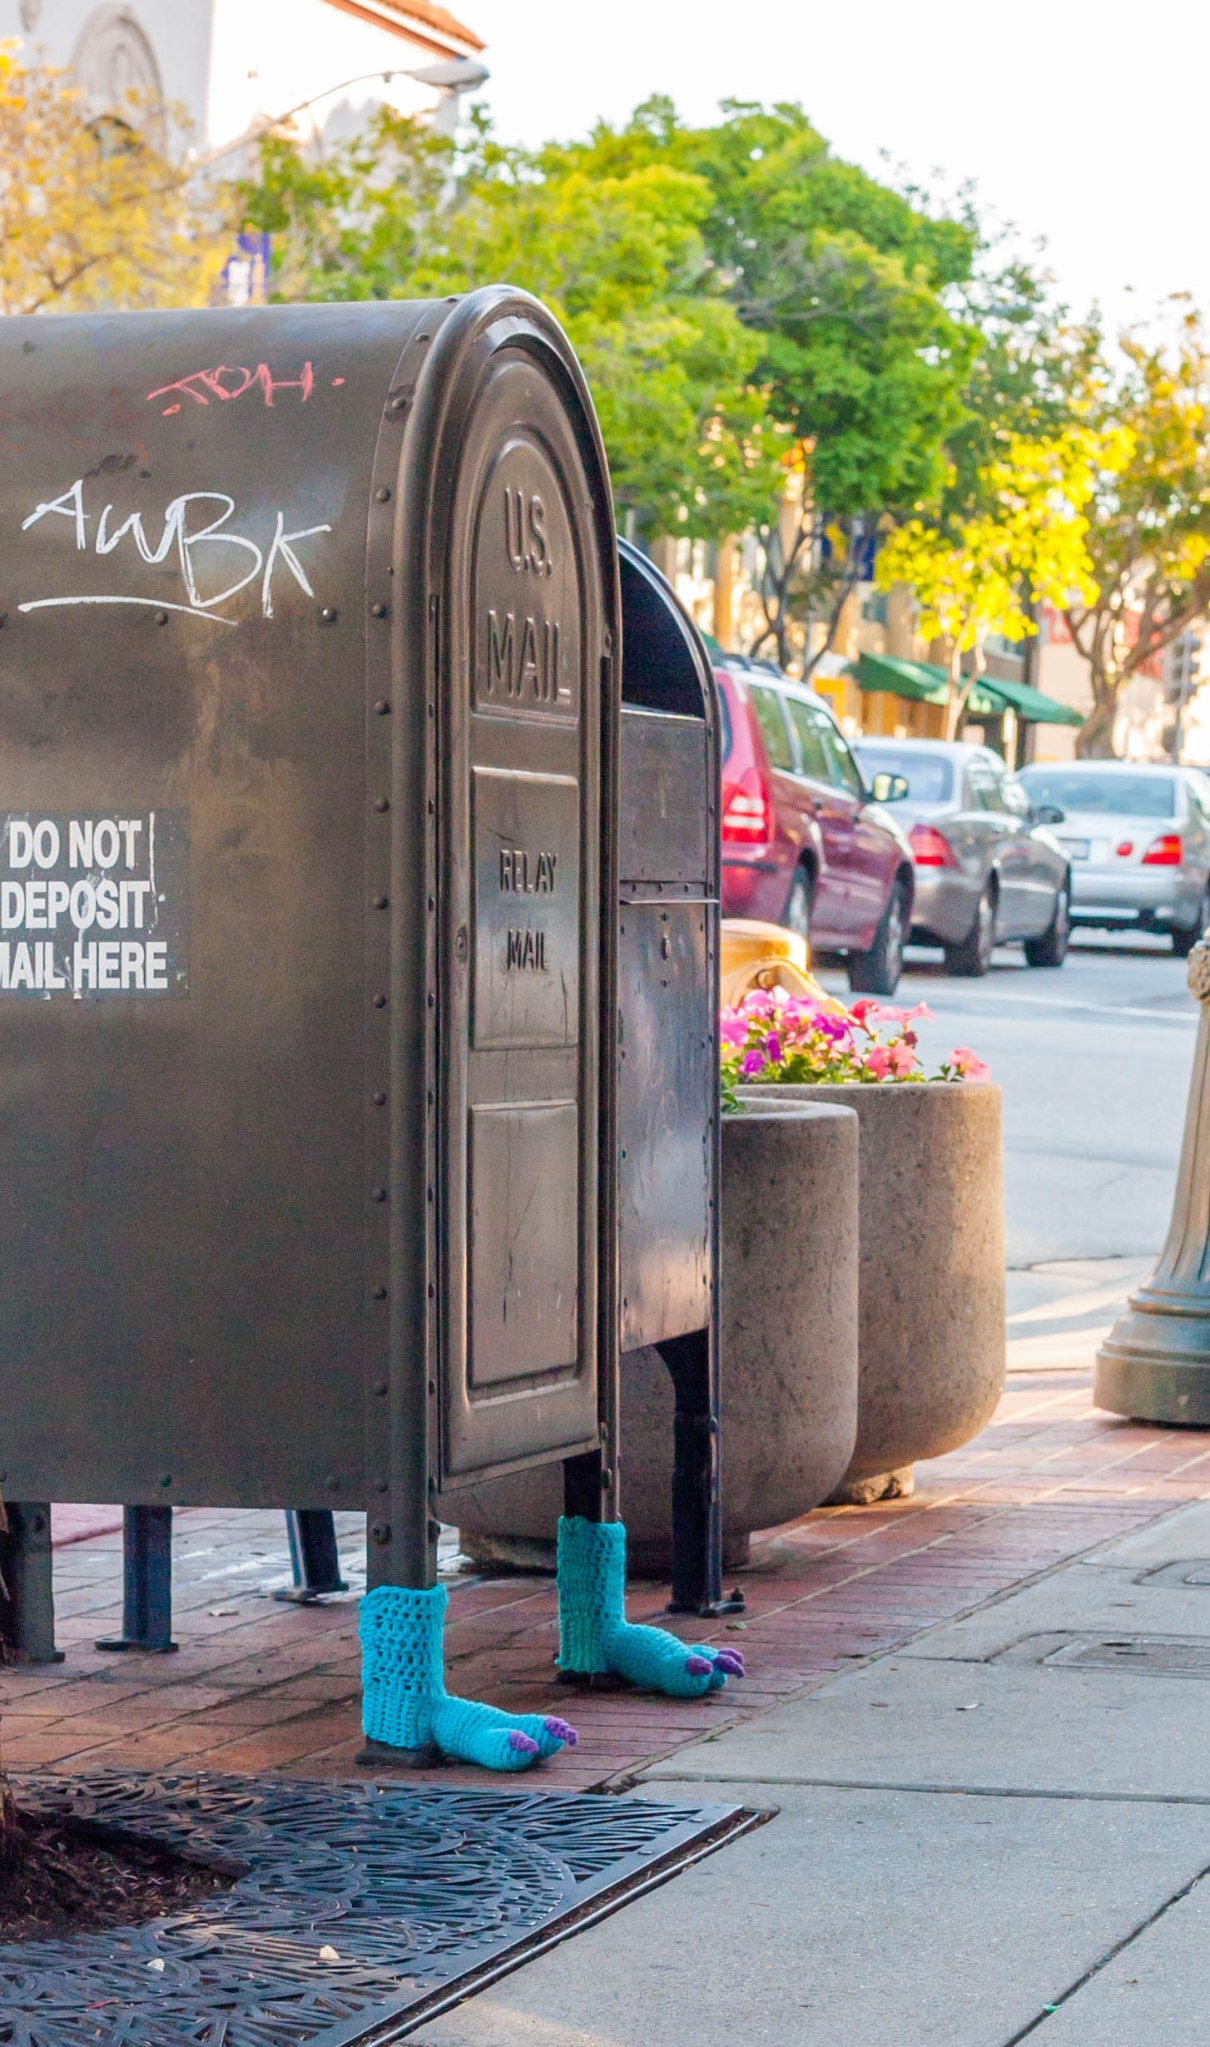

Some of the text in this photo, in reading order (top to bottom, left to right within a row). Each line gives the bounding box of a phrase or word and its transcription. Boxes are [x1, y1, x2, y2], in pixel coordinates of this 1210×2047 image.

[487, 609, 571, 704] MAIL
[9, 819, 142, 870] DO NOT
[500, 849, 558, 893] RELAY
[1, 879, 150, 929] DEPOSIT
[73, 941, 168, 989] HERE
[507, 928, 549, 971] MAIL
